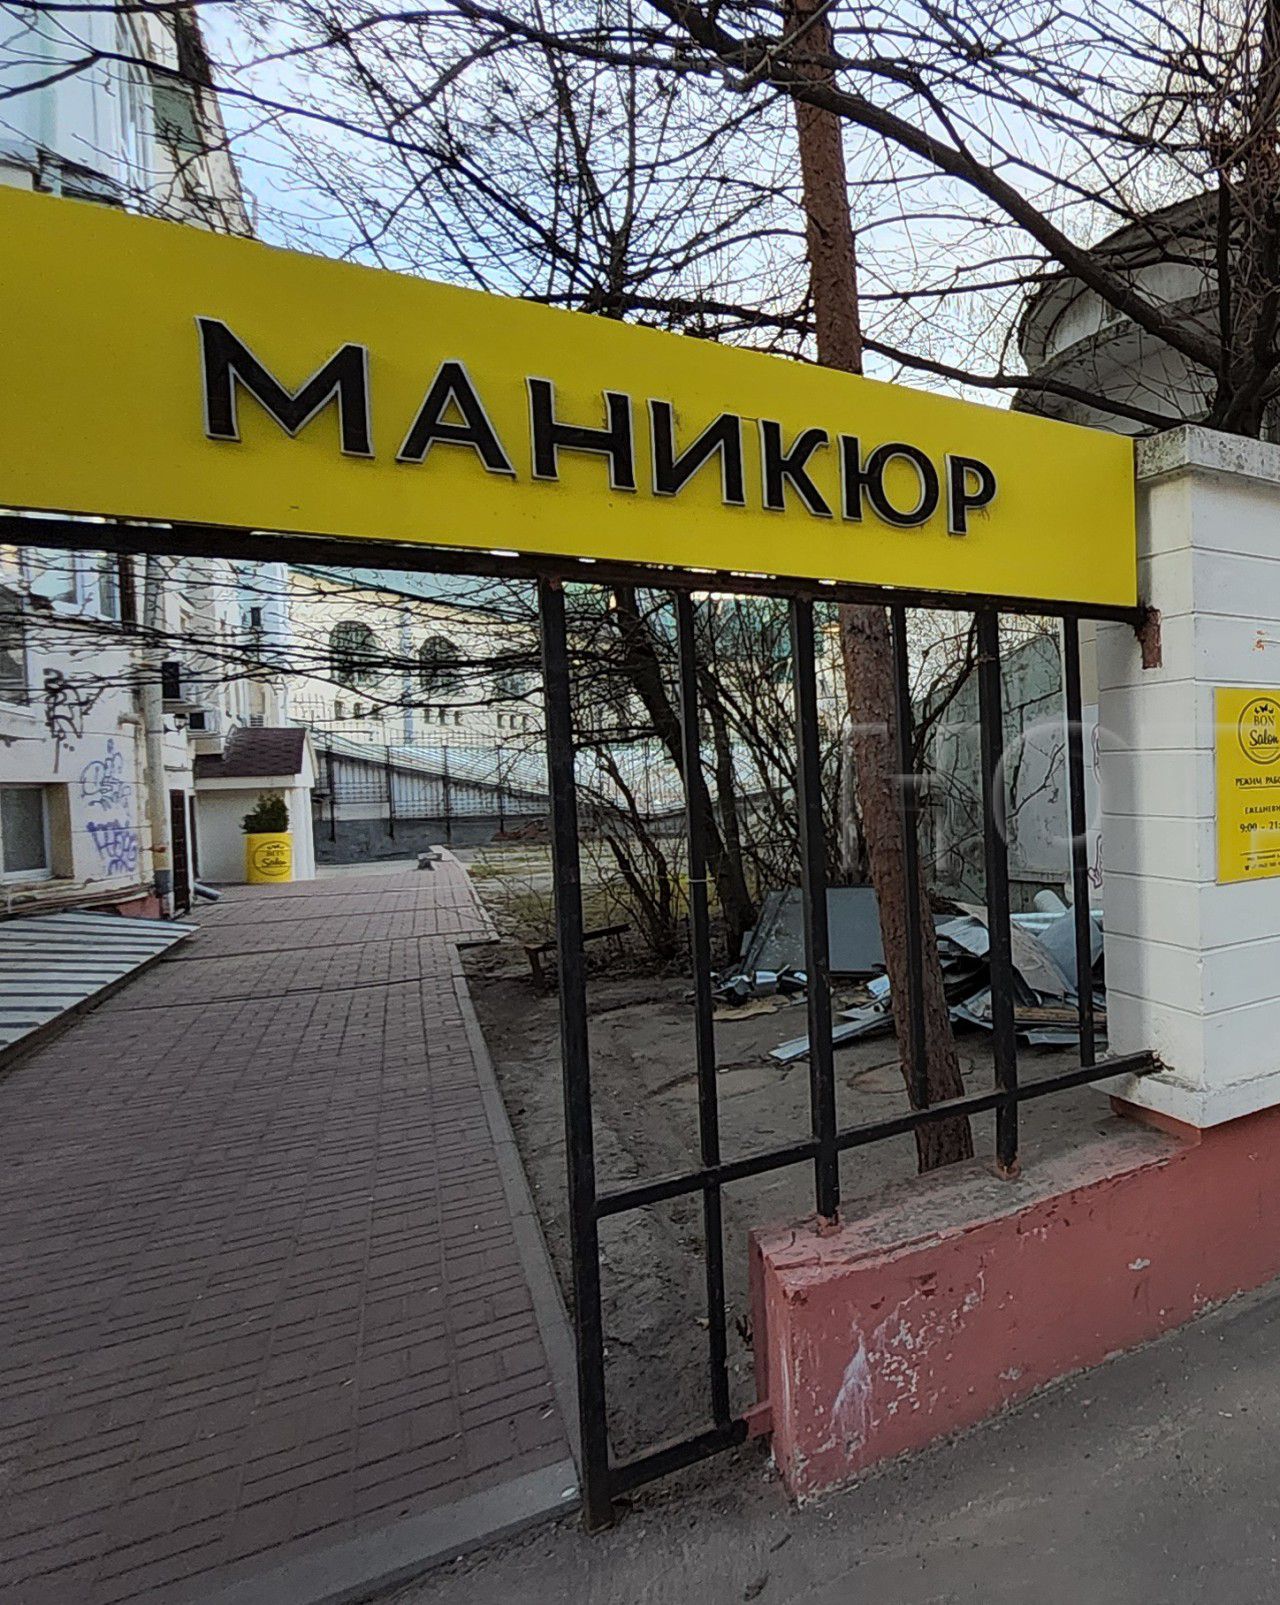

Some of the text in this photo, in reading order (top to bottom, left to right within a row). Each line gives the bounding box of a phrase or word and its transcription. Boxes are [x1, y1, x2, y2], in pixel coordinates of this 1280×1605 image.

[195, 315, 998, 537] МАНИКЮР
[1253, 714, 1276, 726] BON
[1249, 729, 1279, 747] Salon
[1235, 776, 1263, 786] РЕЖИМ
[1239, 822, 1258, 833] 9:00
